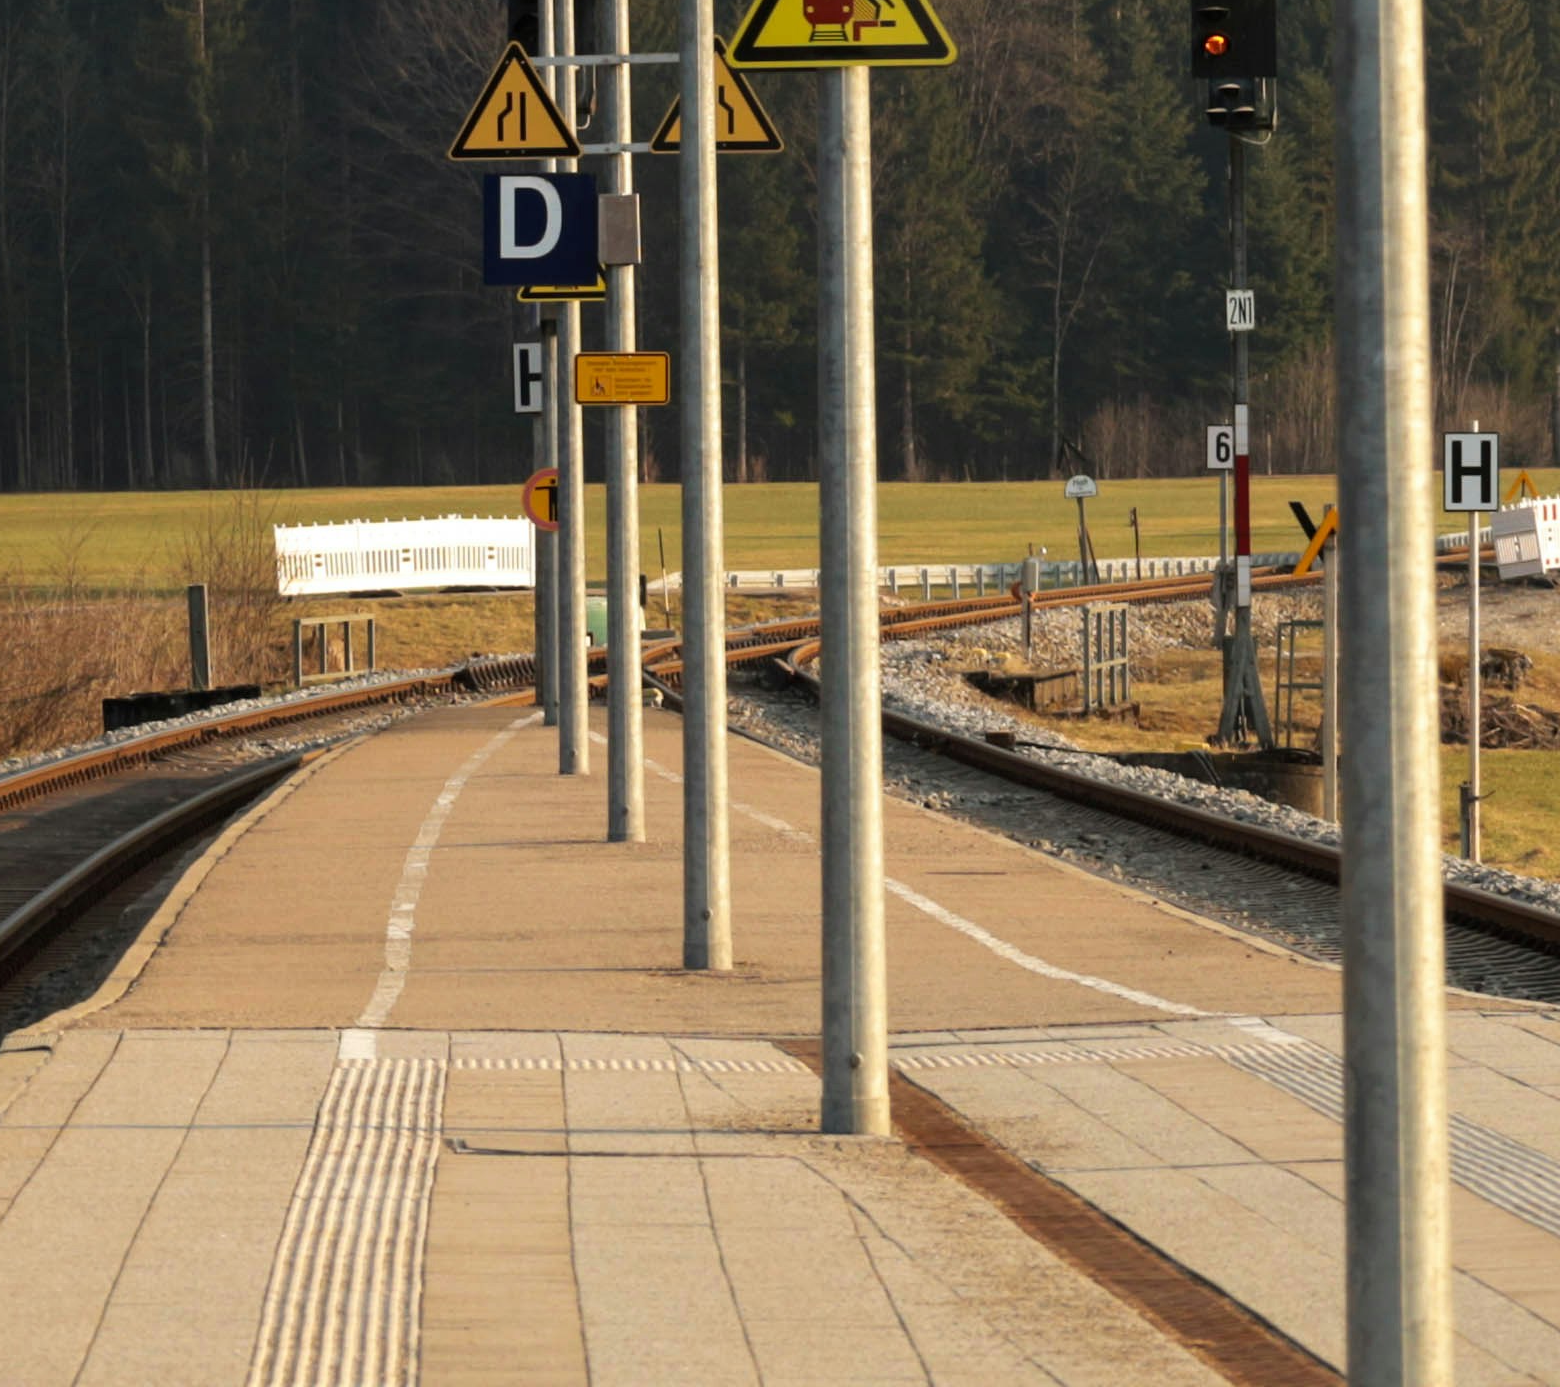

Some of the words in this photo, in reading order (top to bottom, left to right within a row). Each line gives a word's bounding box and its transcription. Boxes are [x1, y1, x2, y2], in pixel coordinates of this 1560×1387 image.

[499, 175, 563, 259] D
[1229, 297, 1252, 324] 2N1
[1216, 432, 1230, 463] 6
[1451, 440, 1492, 504] H
